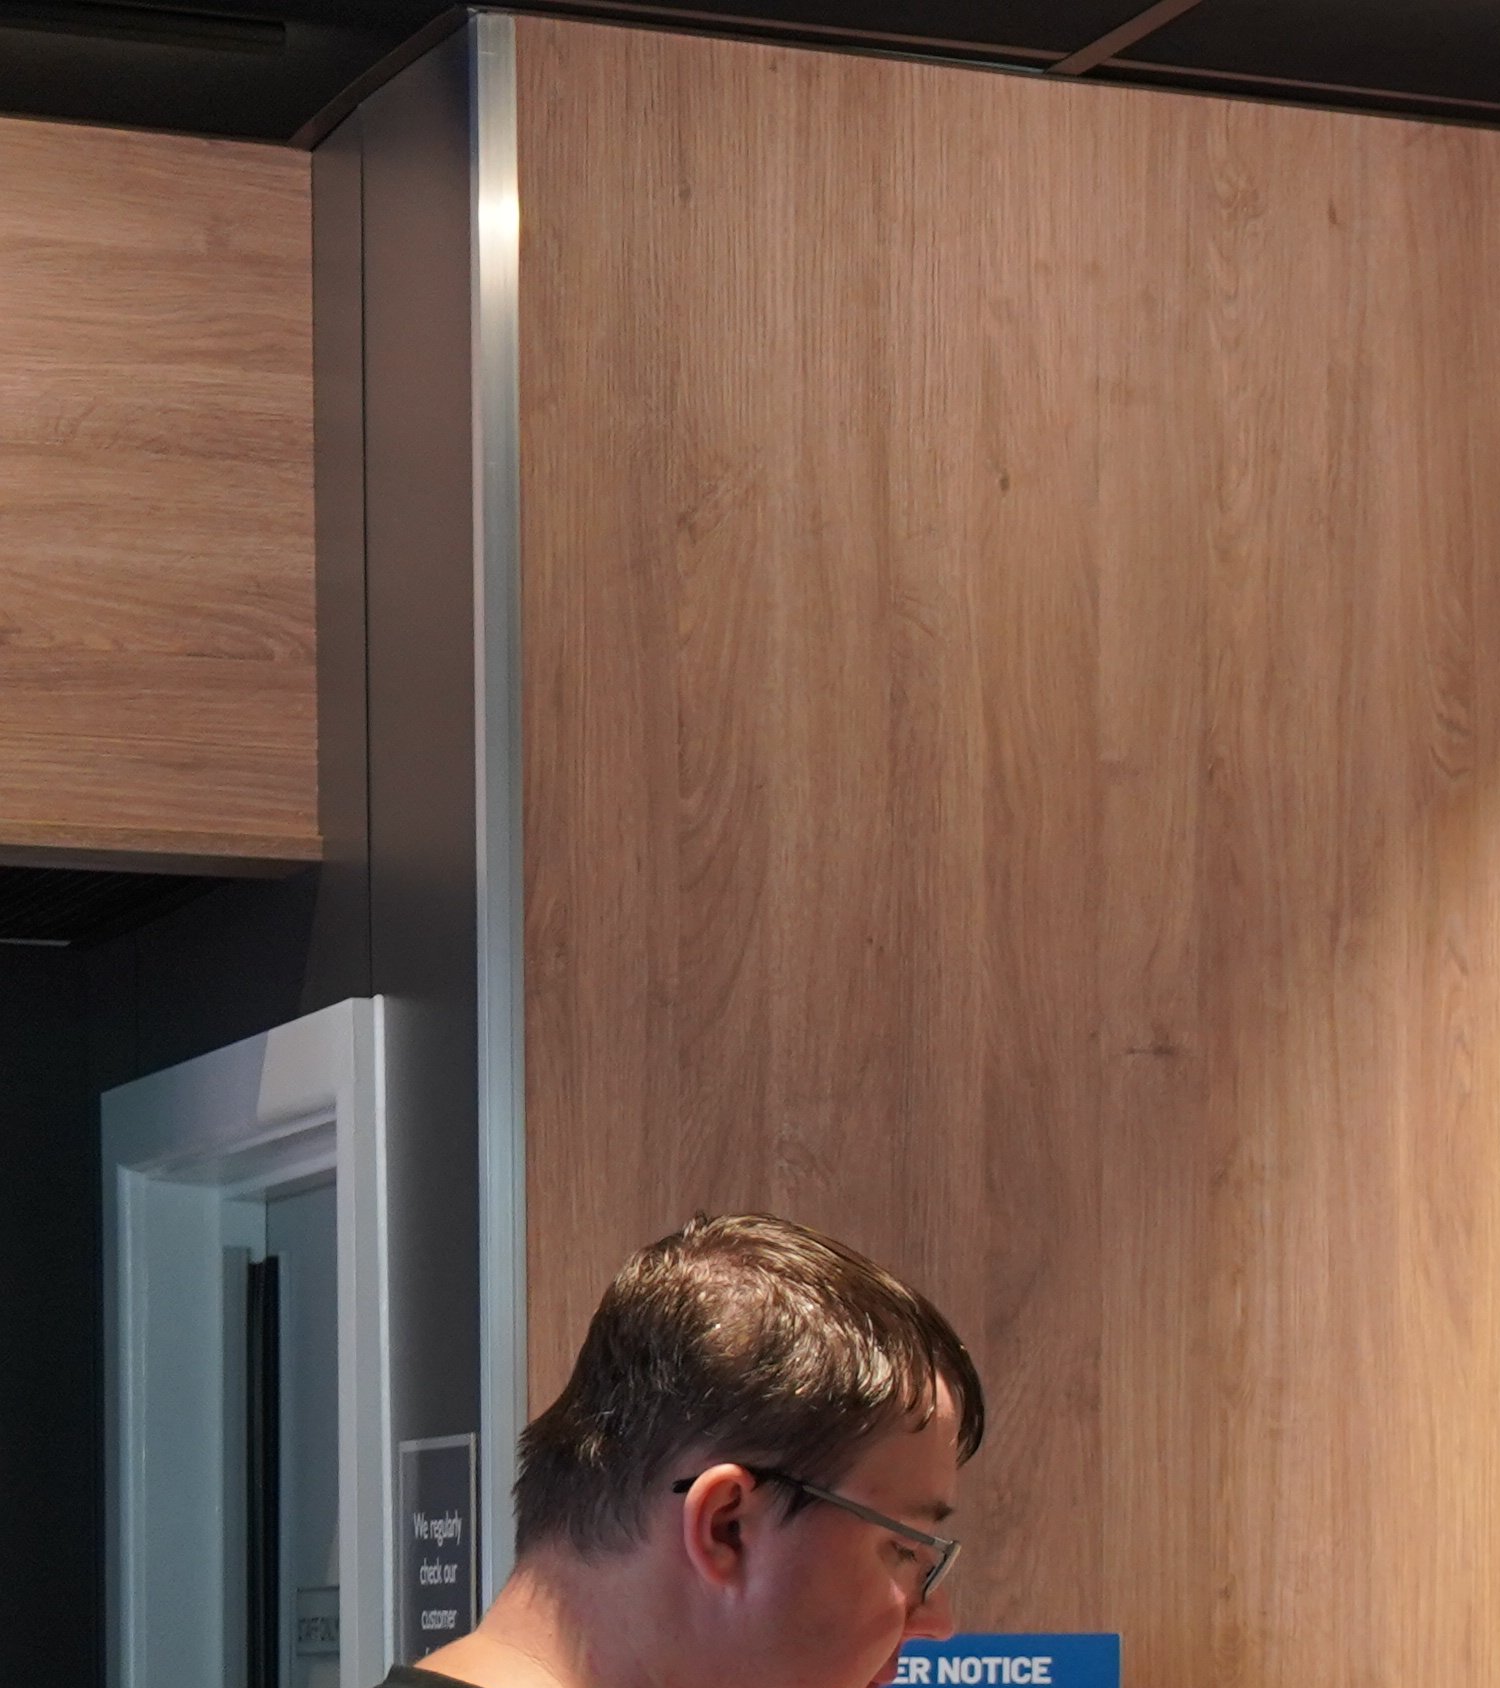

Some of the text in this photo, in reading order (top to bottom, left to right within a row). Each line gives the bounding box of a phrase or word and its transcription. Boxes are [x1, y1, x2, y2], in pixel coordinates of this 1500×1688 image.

[413, 1510, 463, 1547] We regularly
[419, 1558, 458, 1585] check our
[421, 1608, 457, 1631] customer
[938, 1656, 1053, 1685] NOTICE
